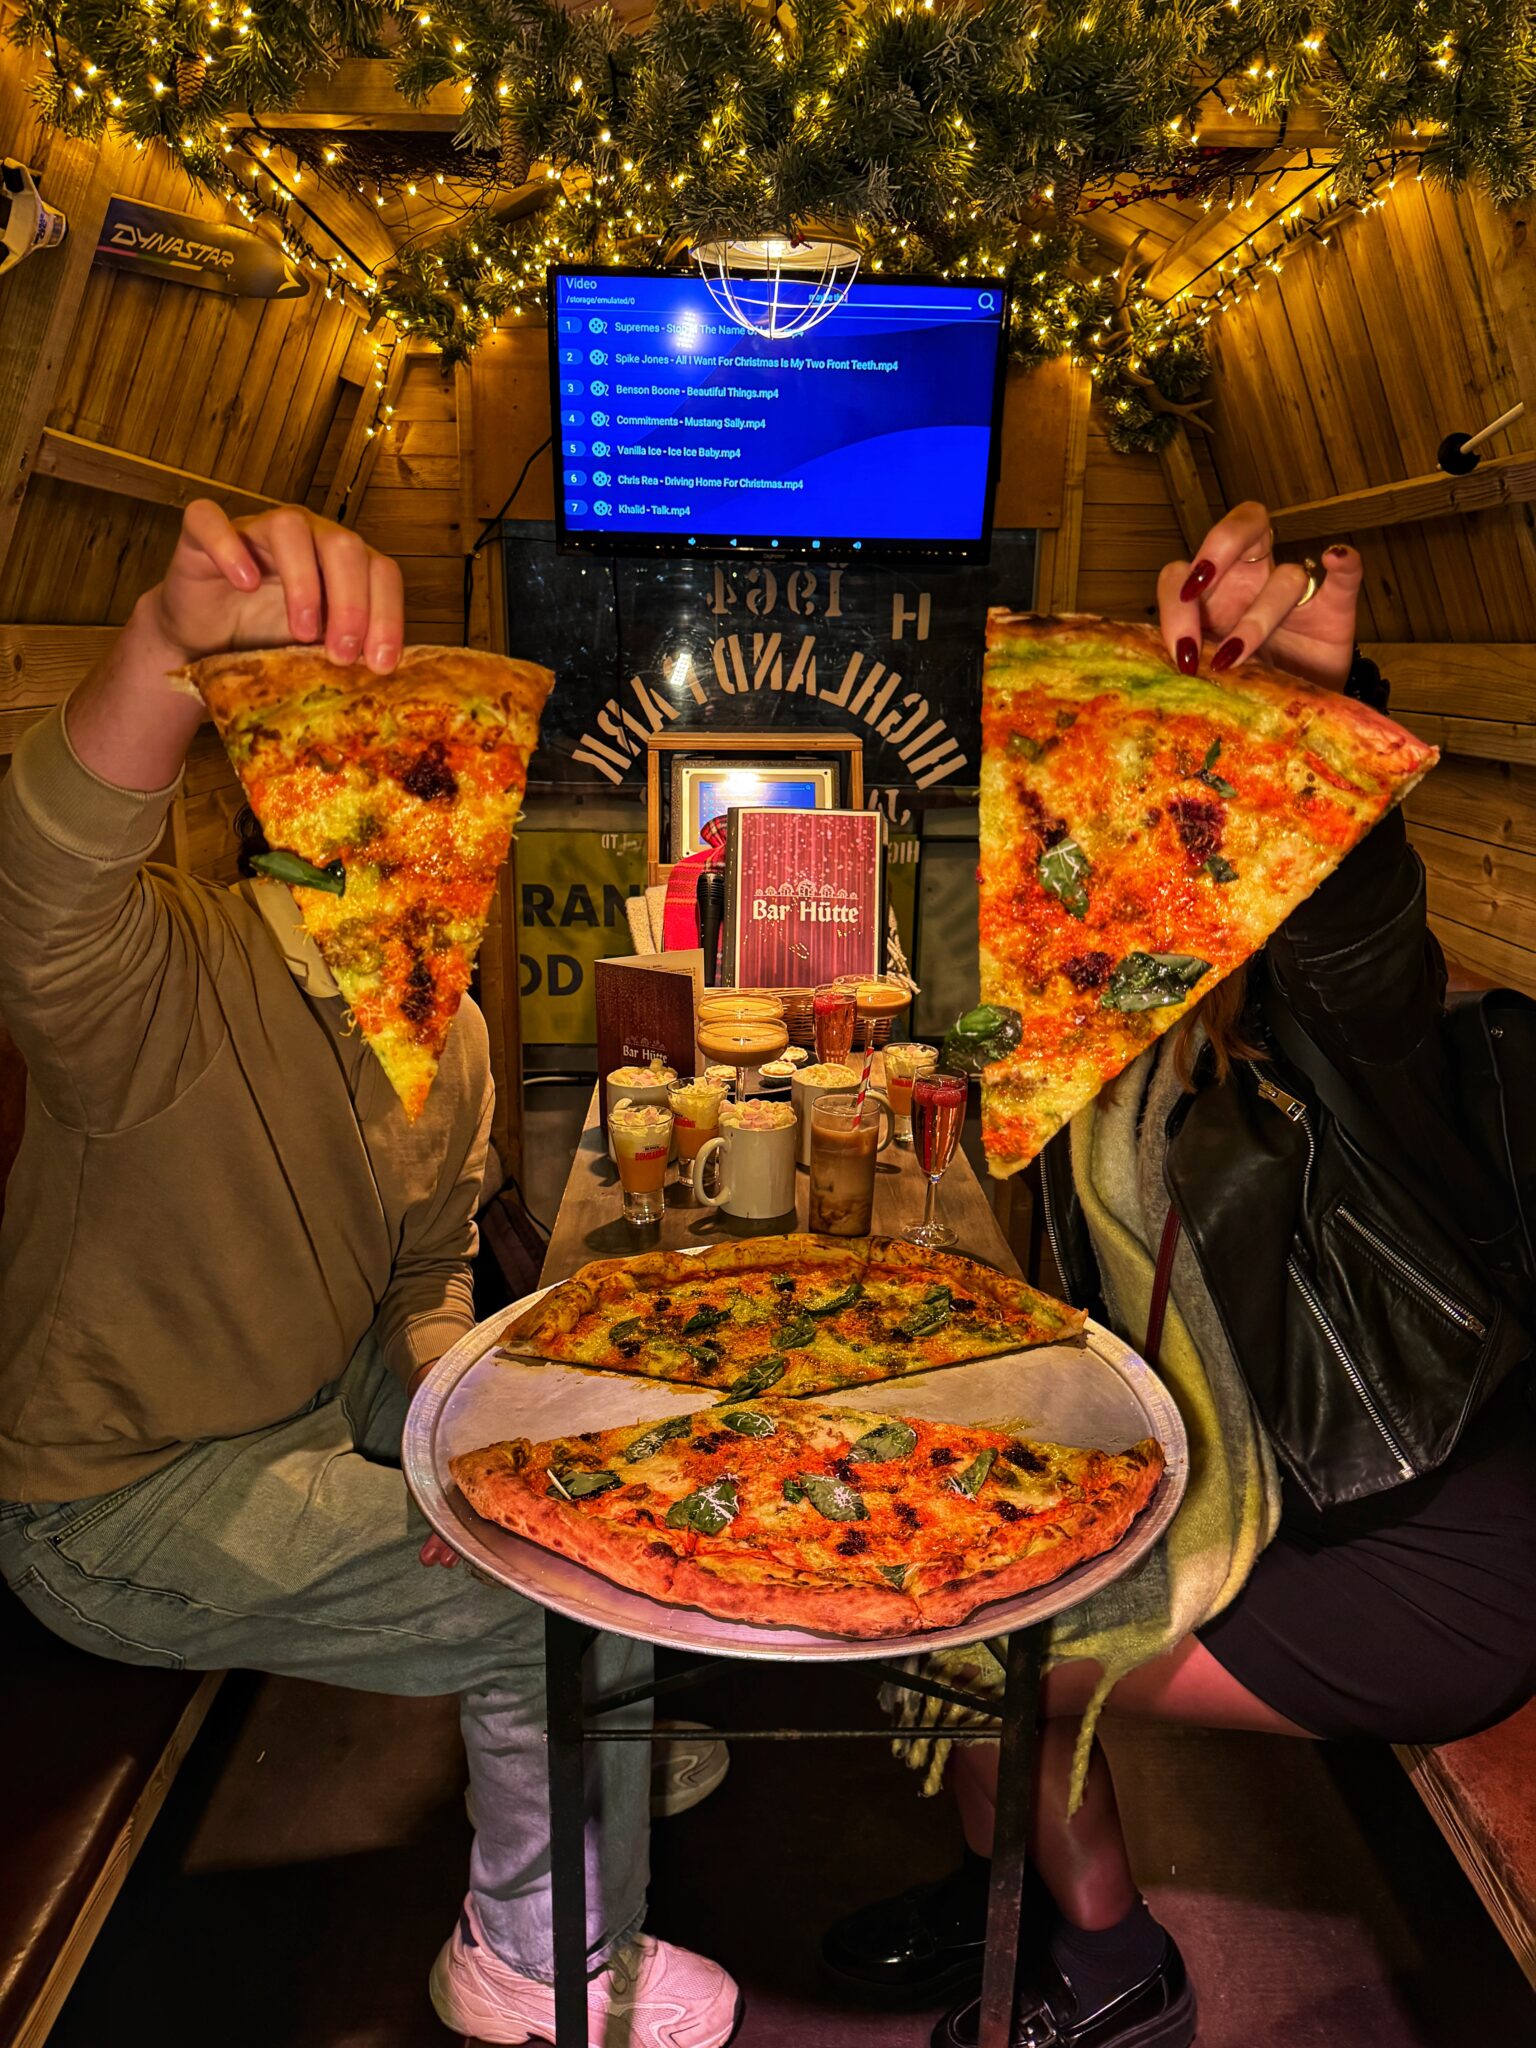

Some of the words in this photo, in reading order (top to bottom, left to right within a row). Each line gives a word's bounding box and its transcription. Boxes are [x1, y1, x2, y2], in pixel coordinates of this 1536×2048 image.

[110, 223, 235, 268] DYNASTAR
[565, 277, 597, 290] Video
[565, 296, 636, 305] /storage/emulated/0
[566, 321, 571, 330] 1
[614, 322, 660, 333] Supremes
[700, 324, 716, 335] The
[718, 325, 745, 335] Name
[567, 352, 573, 361] 2
[615, 354, 640, 365] Spike
[641, 355, 669, 364] Jones
[676, 355, 687, 365] All
[689, 356, 692, 365] I
[694, 356, 717, 366] Want
[718, 357, 733, 366] For
[734, 357, 779, 368] Christmas
[781, 358, 789, 368] Is
[790, 358, 804, 370] My
[805, 358, 826, 369] Two
[827, 359, 850, 369] Front
[851, 360, 898, 373] Teeth.mp4
[568, 384, 574, 393] 3
[616, 385, 650, 395] Benson
[651, 386, 681, 396] Boone
[687, 386, 726, 397] Beautiful
[727, 387, 779, 400] Things.mp4
[568, 414, 575, 423] 4
[616, 415, 679, 426] Commitments
[684, 417, 723, 429] Mustang
[724, 418, 766, 430] Sally.mp4
[570, 444, 576, 453] 5
[617, 445, 646, 455] Vanilla
[648, 446, 662, 456] Ice
[668, 446, 682, 456] Ice
[683, 446, 697, 457] Ice
[698, 447, 741, 460] Baby.mp4
[571, 474, 577, 483] 6
[618, 475, 640, 485] Chris
[641, 476, 659, 486] Rea
[665, 476, 694, 488] Driving
[695, 477, 722, 487] Home
[723, 478, 738, 487] For
[739, 478, 804, 491] Christmas.mp4
[572, 503, 578, 512] 7
[618, 504, 645, 514] Khalid
[651, 505, 691, 517] Talk.mp4
[753, 899, 791, 921] Bar
[799, 901, 860, 924] Hütte
[623, 1044, 639, 1059] Bar
